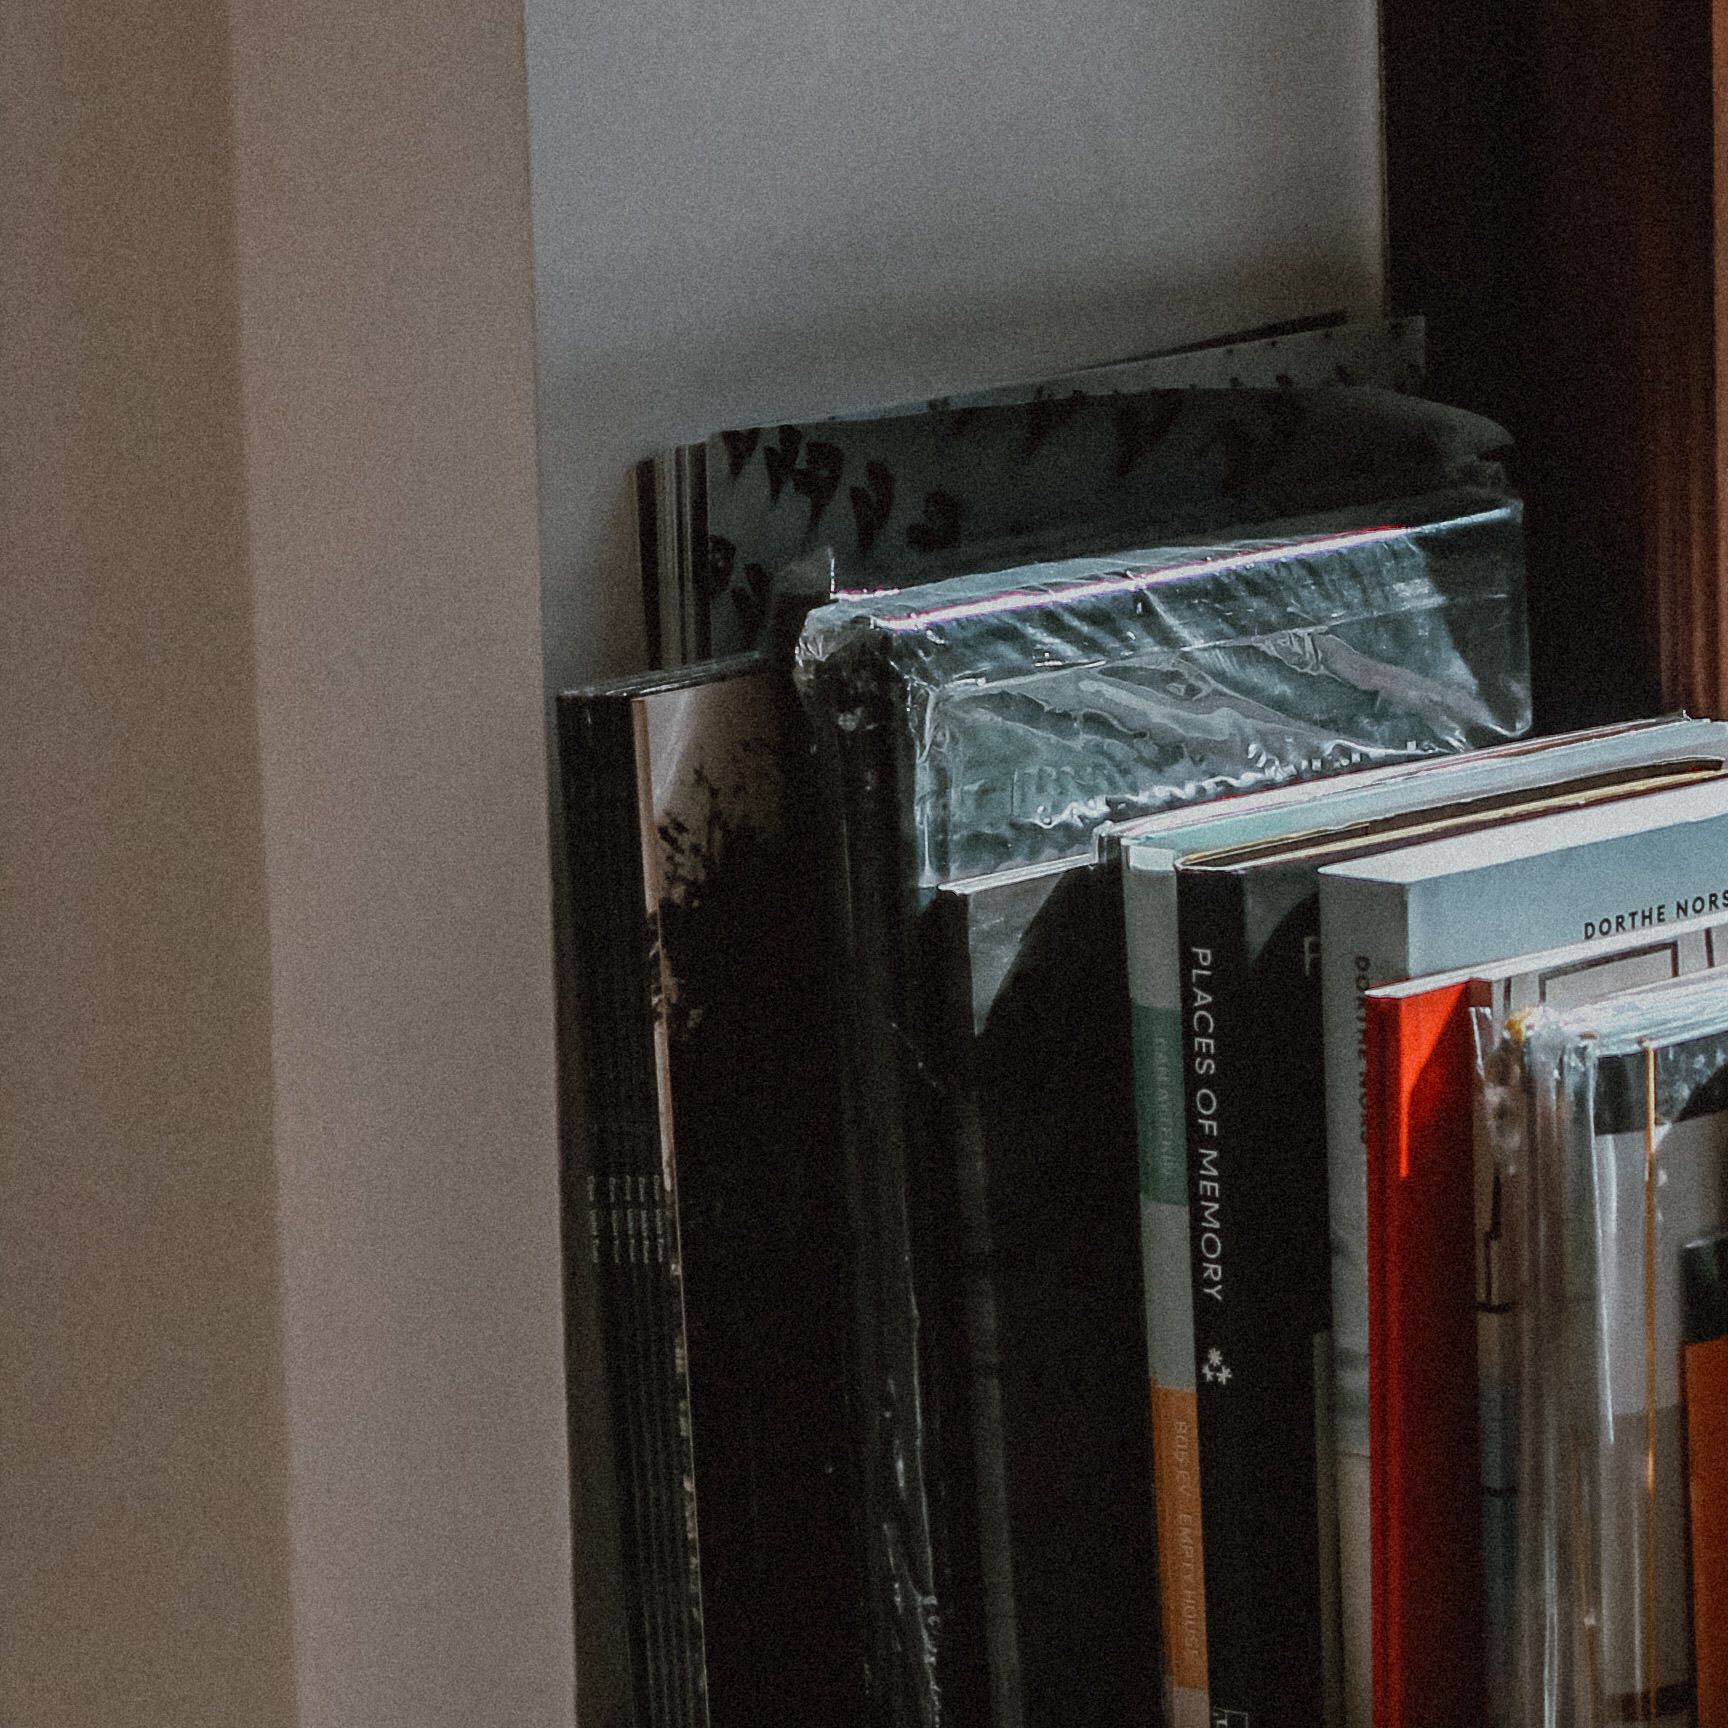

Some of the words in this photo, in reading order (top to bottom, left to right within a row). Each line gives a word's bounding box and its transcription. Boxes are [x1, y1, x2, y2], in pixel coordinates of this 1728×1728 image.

[1583, 903, 1667, 941] DORTHE
[1191, 946, 1216, 1075] PLACES
[1196, 1088, 1218, 1138] OF
[1198, 1148, 1223, 1302] MEMORY
[1178, 1513, 1196, 1586] EMPTY
